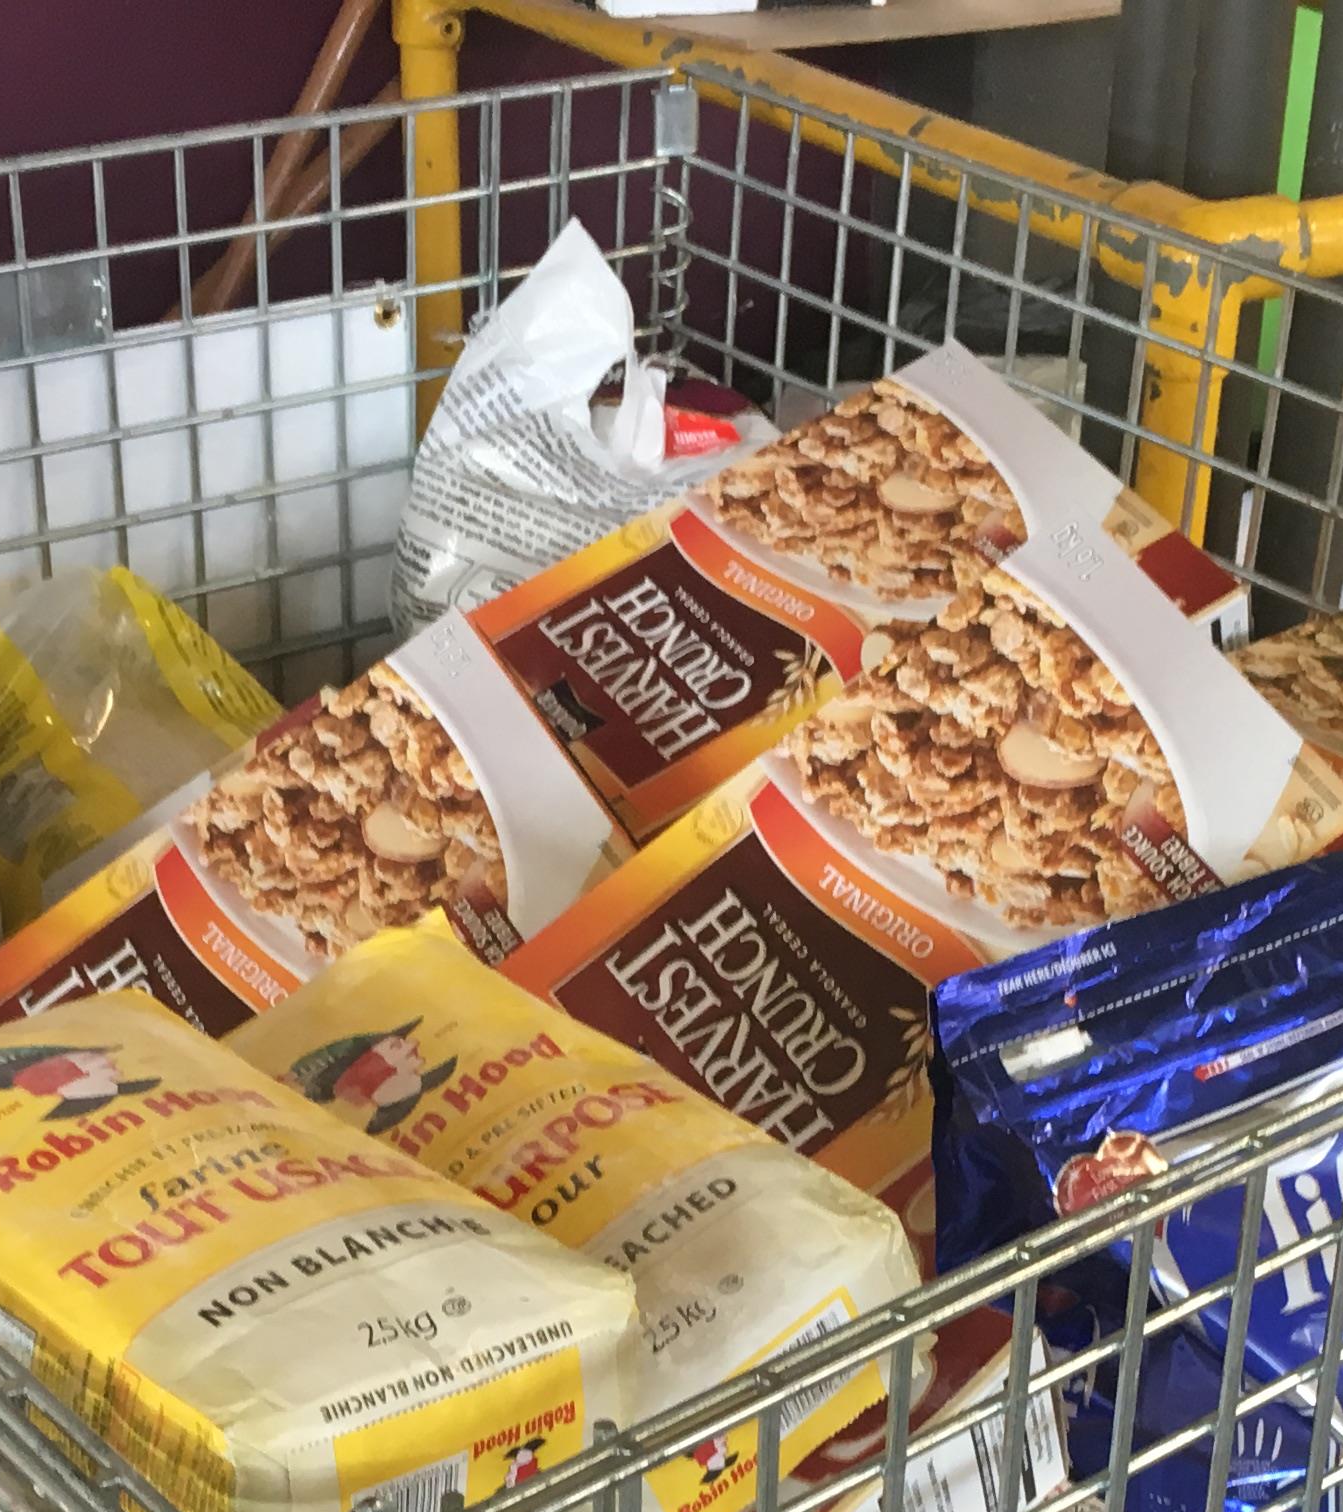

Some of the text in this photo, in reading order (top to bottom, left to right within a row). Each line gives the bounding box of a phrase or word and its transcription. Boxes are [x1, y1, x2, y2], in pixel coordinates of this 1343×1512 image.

[722, 559, 816, 623] ORIGINAL
[537, 597, 722, 761] HARVEST
[603, 575, 753, 710] CRUNCH
[1122, 825, 1174, 882] SOURCE
[818, 862, 935, 959] ORIGINAL
[677, 887, 867, 1096] CRUNCH
[762, 902, 868, 1030] GRANOLA CEREAL
[441, 1032, 567, 1116] Hood
[605, 922, 835, 1152] HARVEST
[139, 1139, 291, 1213] farine
[530, 1153, 605, 1227] our
[57, 1152, 441, 1289] TOUT USA
[606, 1176, 738, 1274] ACHED
[197, 1268, 292, 1328] NON
[319, 1378, 411, 1424] BLANCHIE
[412, 1364, 455, 1391] NON
[473, 1399, 577, 1461] Robin Hood
[727, 1453, 760, 1495] Hoo
